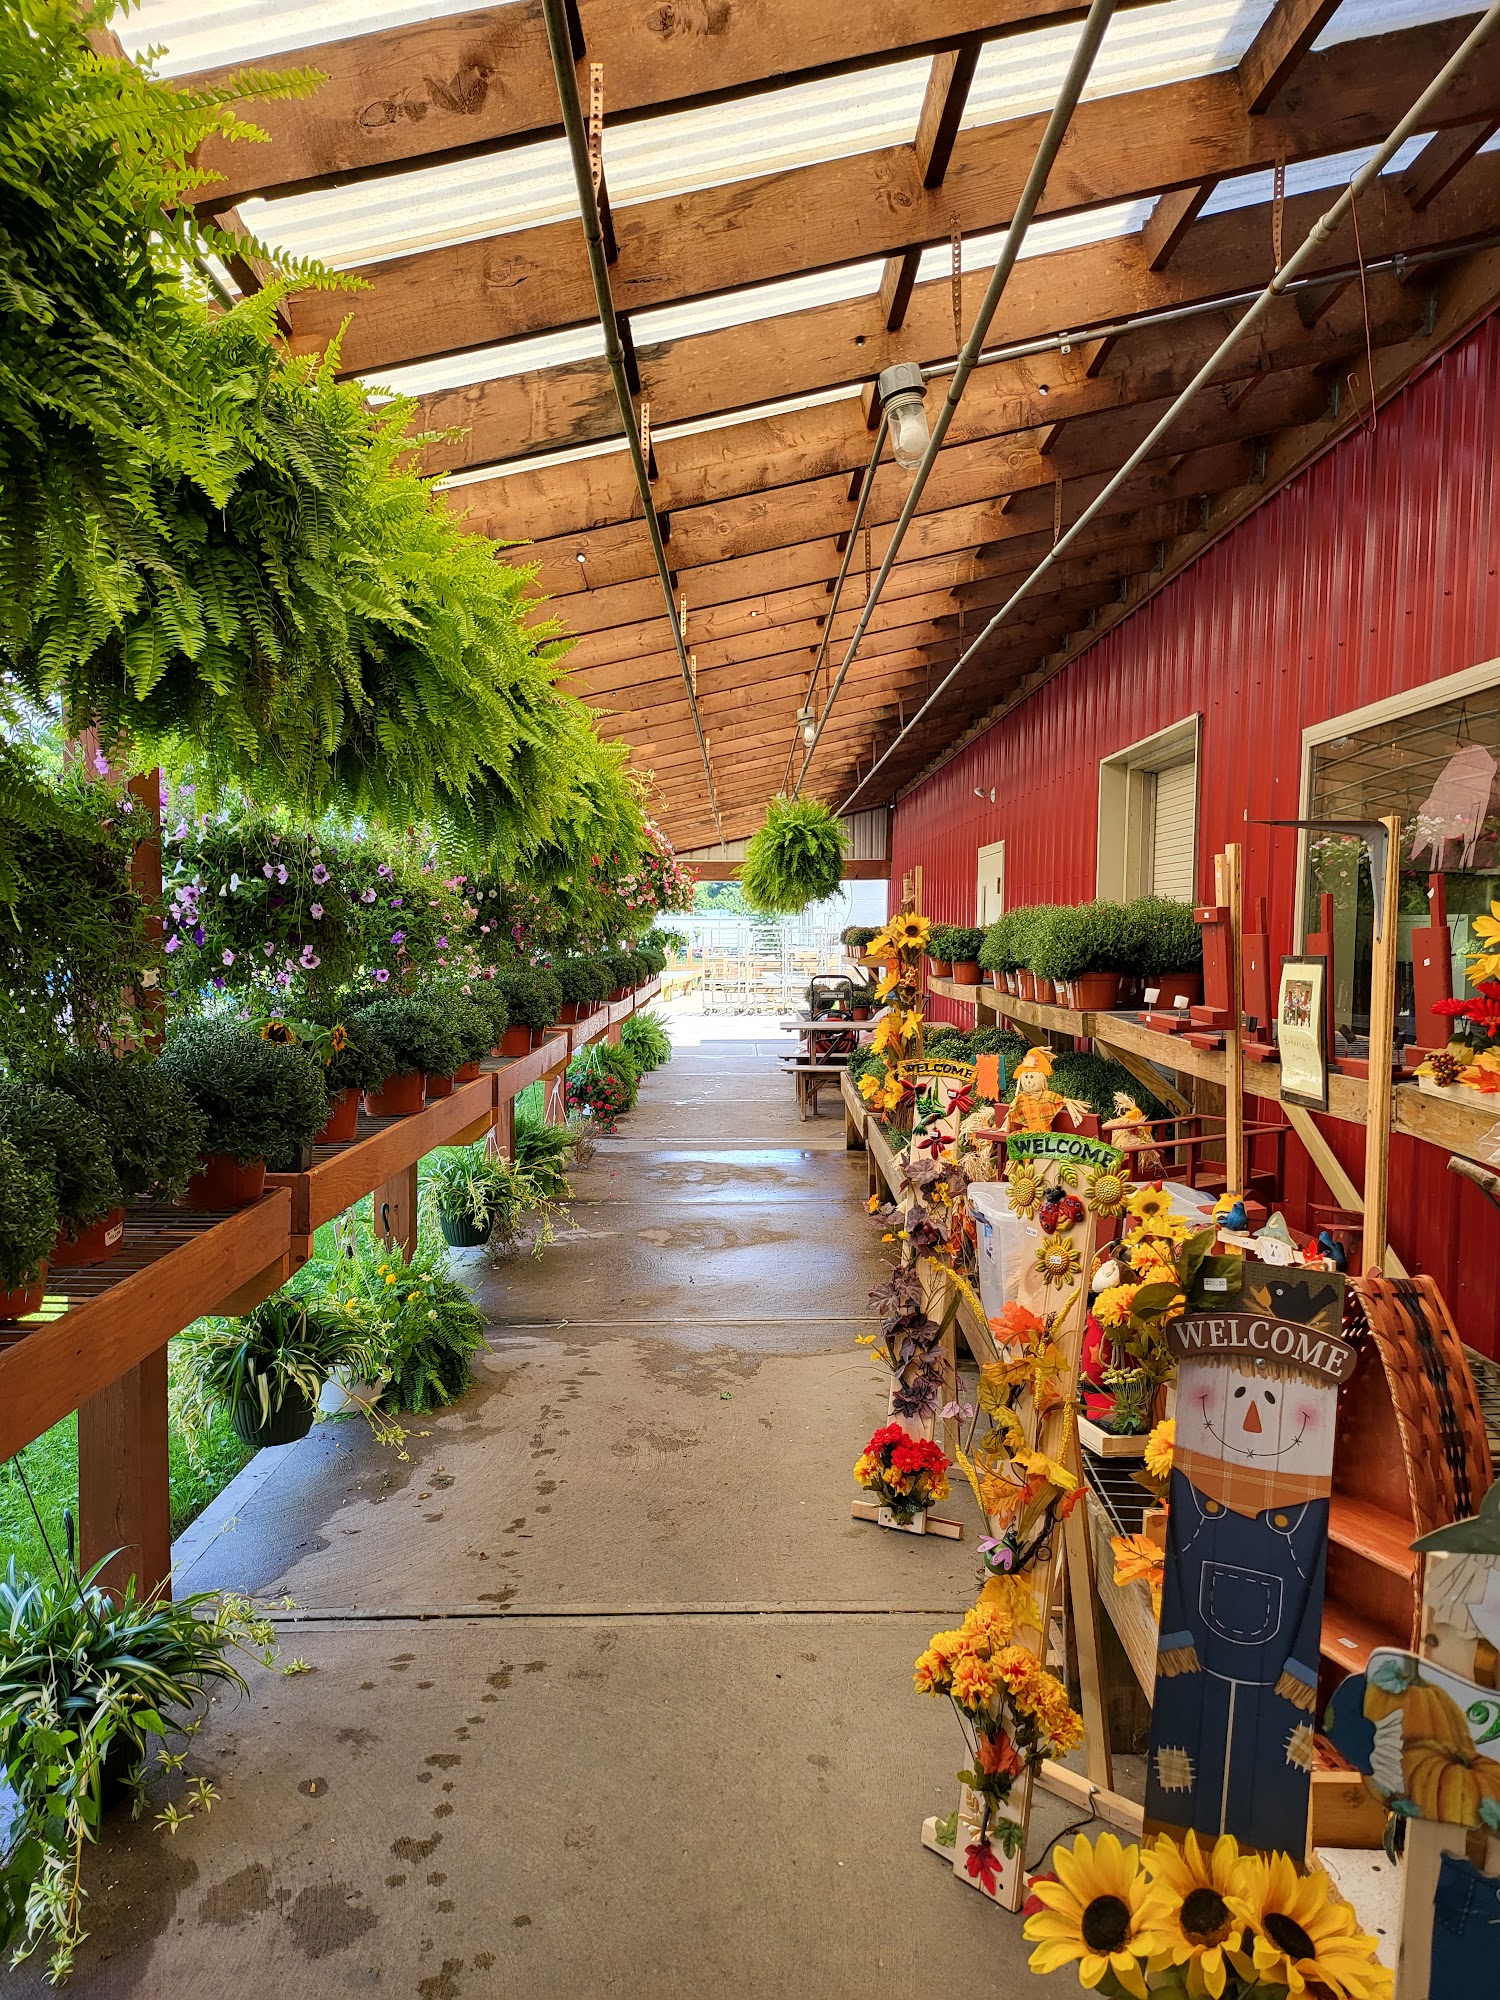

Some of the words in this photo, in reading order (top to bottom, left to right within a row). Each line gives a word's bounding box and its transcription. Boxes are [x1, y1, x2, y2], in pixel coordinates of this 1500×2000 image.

[902, 1062, 974, 1079] WELCOME
[1013, 1137, 1117, 1168] WELCOME
[1173, 1319, 1349, 1377] WELCOME
